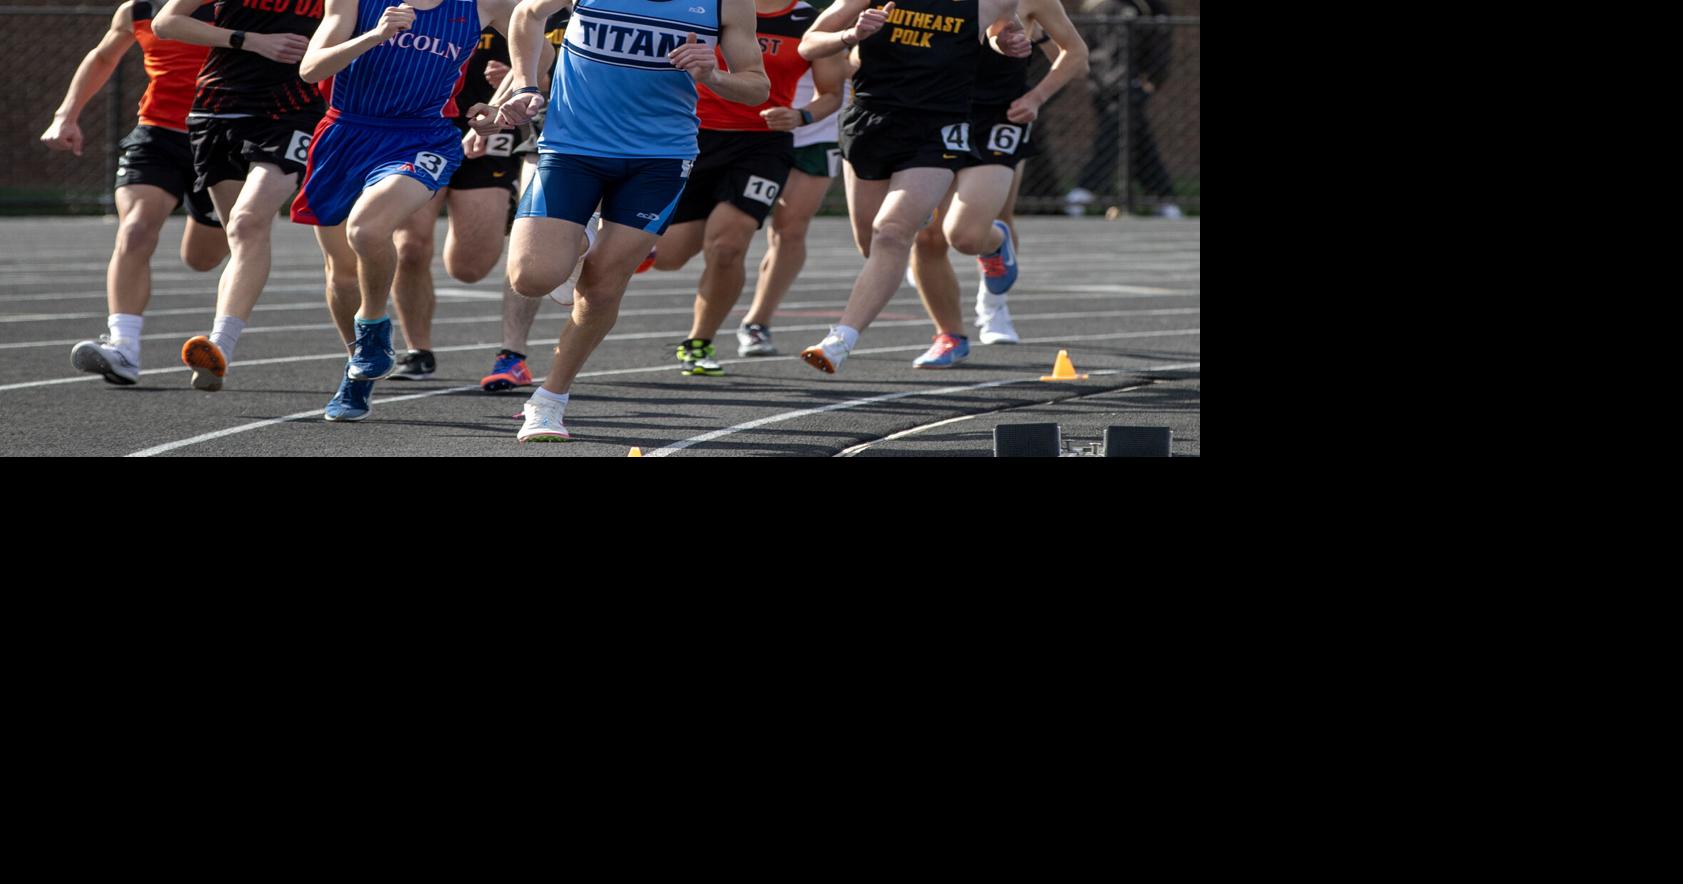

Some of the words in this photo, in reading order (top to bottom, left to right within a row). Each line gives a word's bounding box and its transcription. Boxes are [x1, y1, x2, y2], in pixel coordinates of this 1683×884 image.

[876, 5, 965, 34] OUTHEAST
[580, 20, 706, 58] TITAN
[890, 27, 933, 48] POLK
[492, 137, 509, 151] 2
[946, 124, 965, 148] 4
[994, 126, 1015, 149] 6
[294, 135, 311, 161] 8
[420, 153, 443, 174] 3
[751, 180, 777, 200] 10
